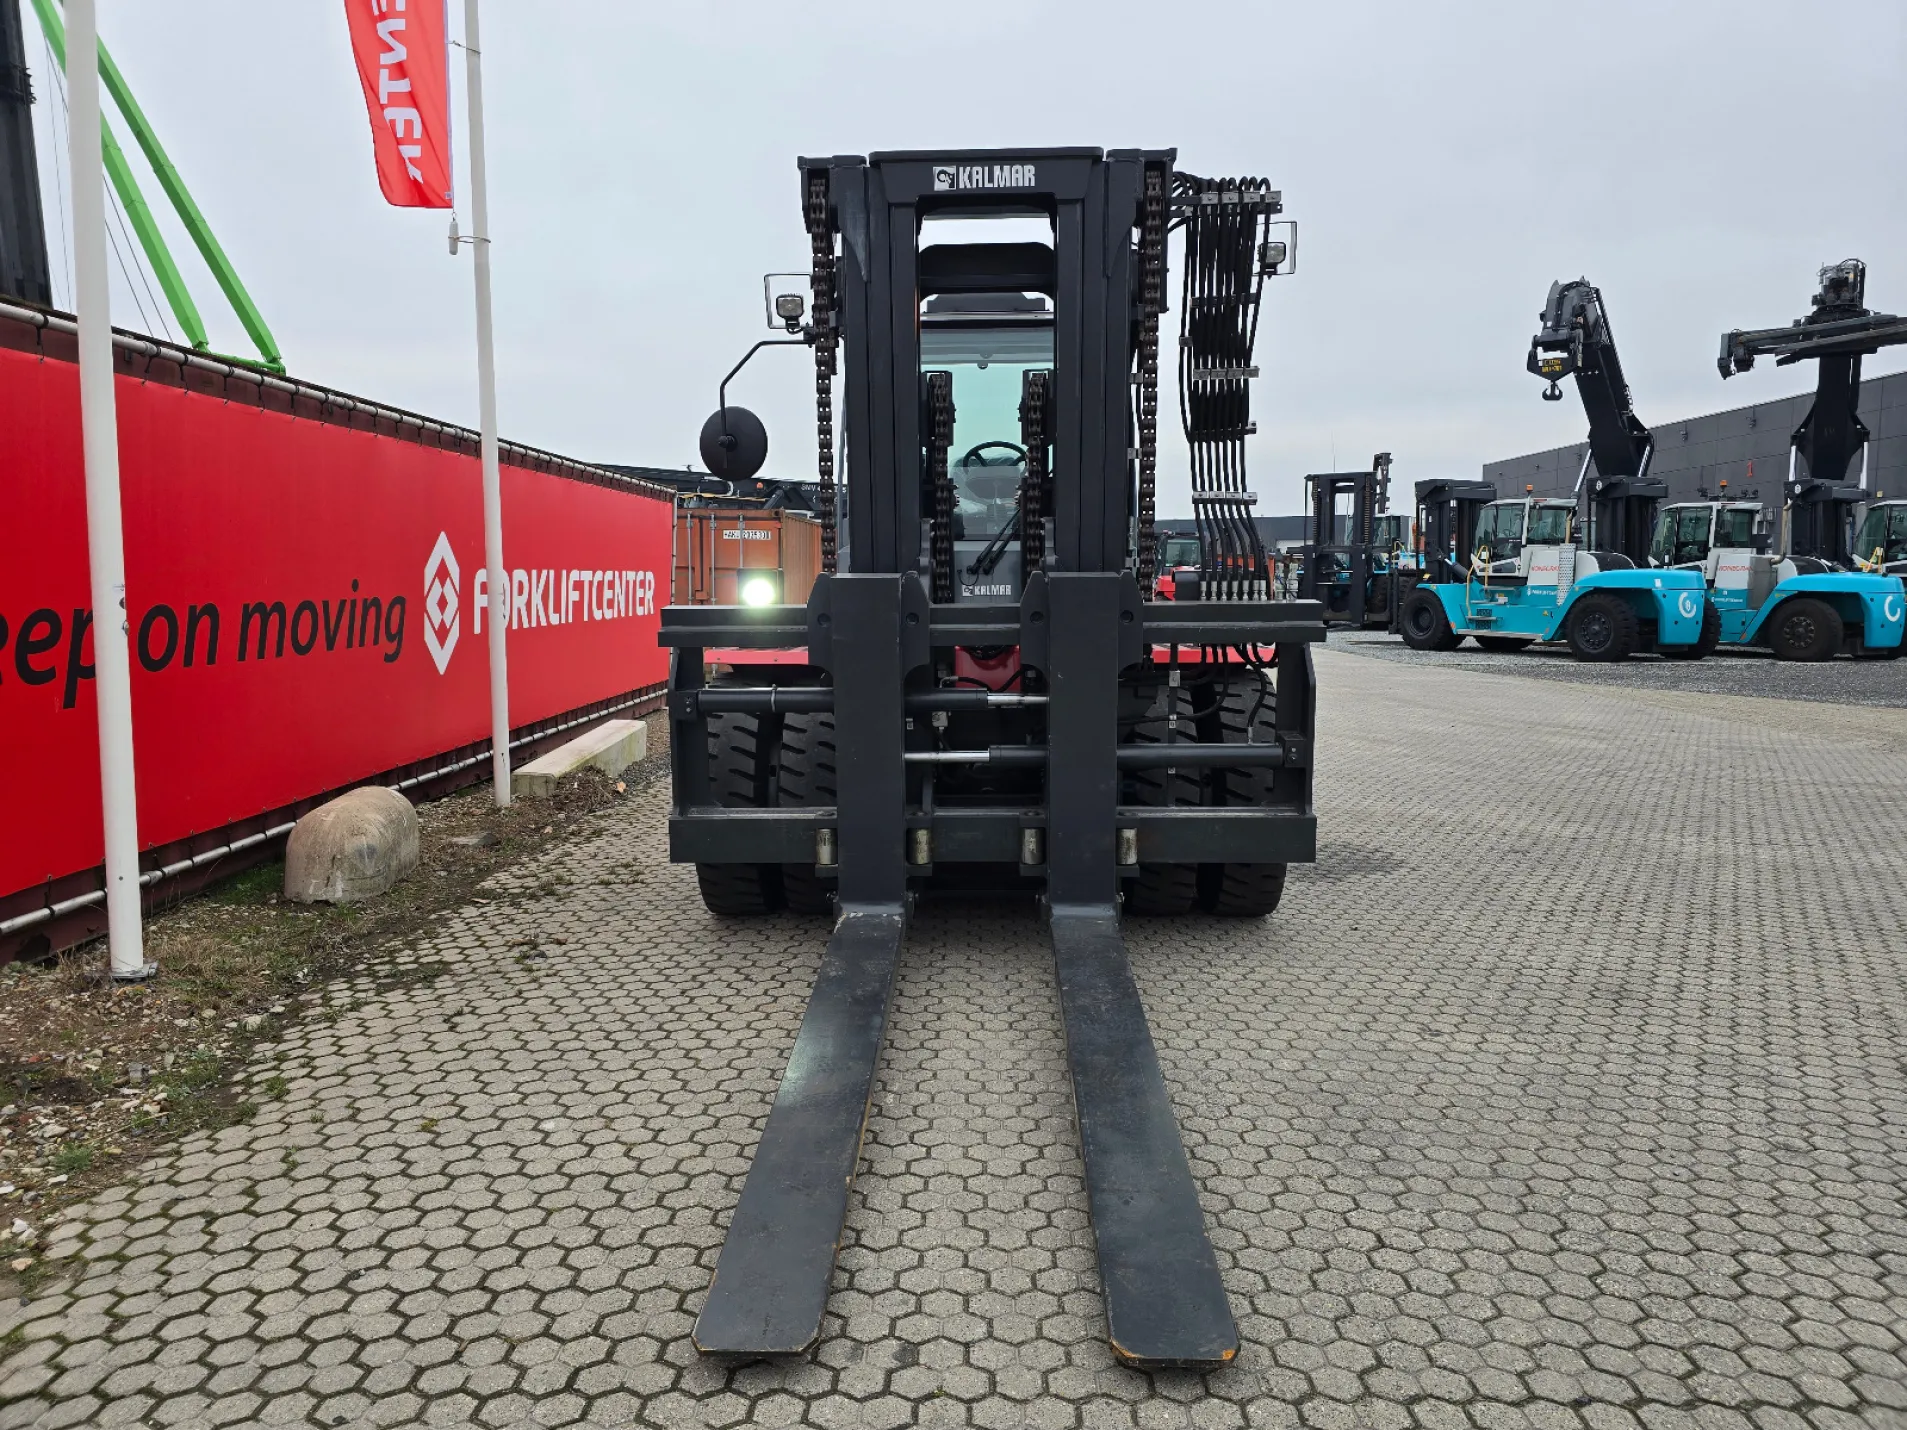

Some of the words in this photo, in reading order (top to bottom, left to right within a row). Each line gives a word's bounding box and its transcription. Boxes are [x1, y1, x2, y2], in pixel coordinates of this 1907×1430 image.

[958, 164, 1036, 189] KALMAR
[974, 584, 1012, 596] KALMAR
[137, 602, 219, 673] on
[237, 579, 407, 664] moving
